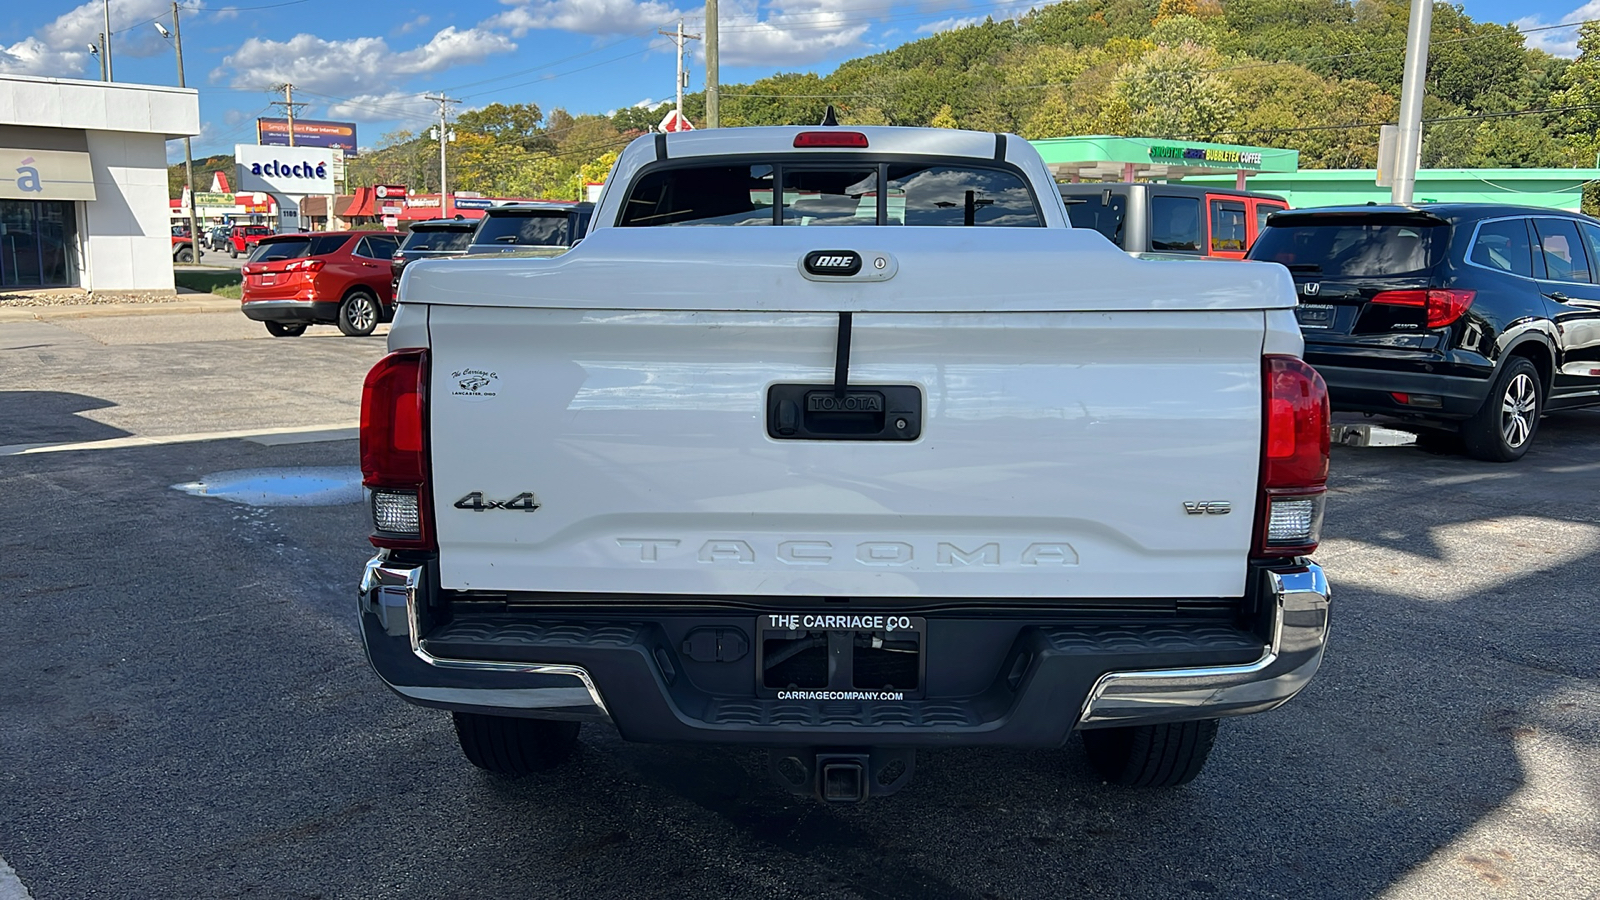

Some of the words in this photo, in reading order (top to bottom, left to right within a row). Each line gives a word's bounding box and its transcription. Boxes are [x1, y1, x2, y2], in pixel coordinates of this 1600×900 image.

[1240, 152, 1262, 164] COFFEE
[251, 160, 327, 179] acloché
[283, 210, 297, 218] 1109
[815, 256, 854, 267] ARE
[451, 370, 461, 379] The
[463, 368, 488, 377] Carriage
[812, 397, 878, 410] TOYOTA
[1183, 500, 1232, 515] V6
[616, 538, 1080, 568] TACOMA
[769, 615, 800, 628] THE
[803, 615, 883, 628] CARRIAGE
[887, 616, 914, 630] CO.
[777, 691, 903, 701] CARRIAGECOMPANY.COM
